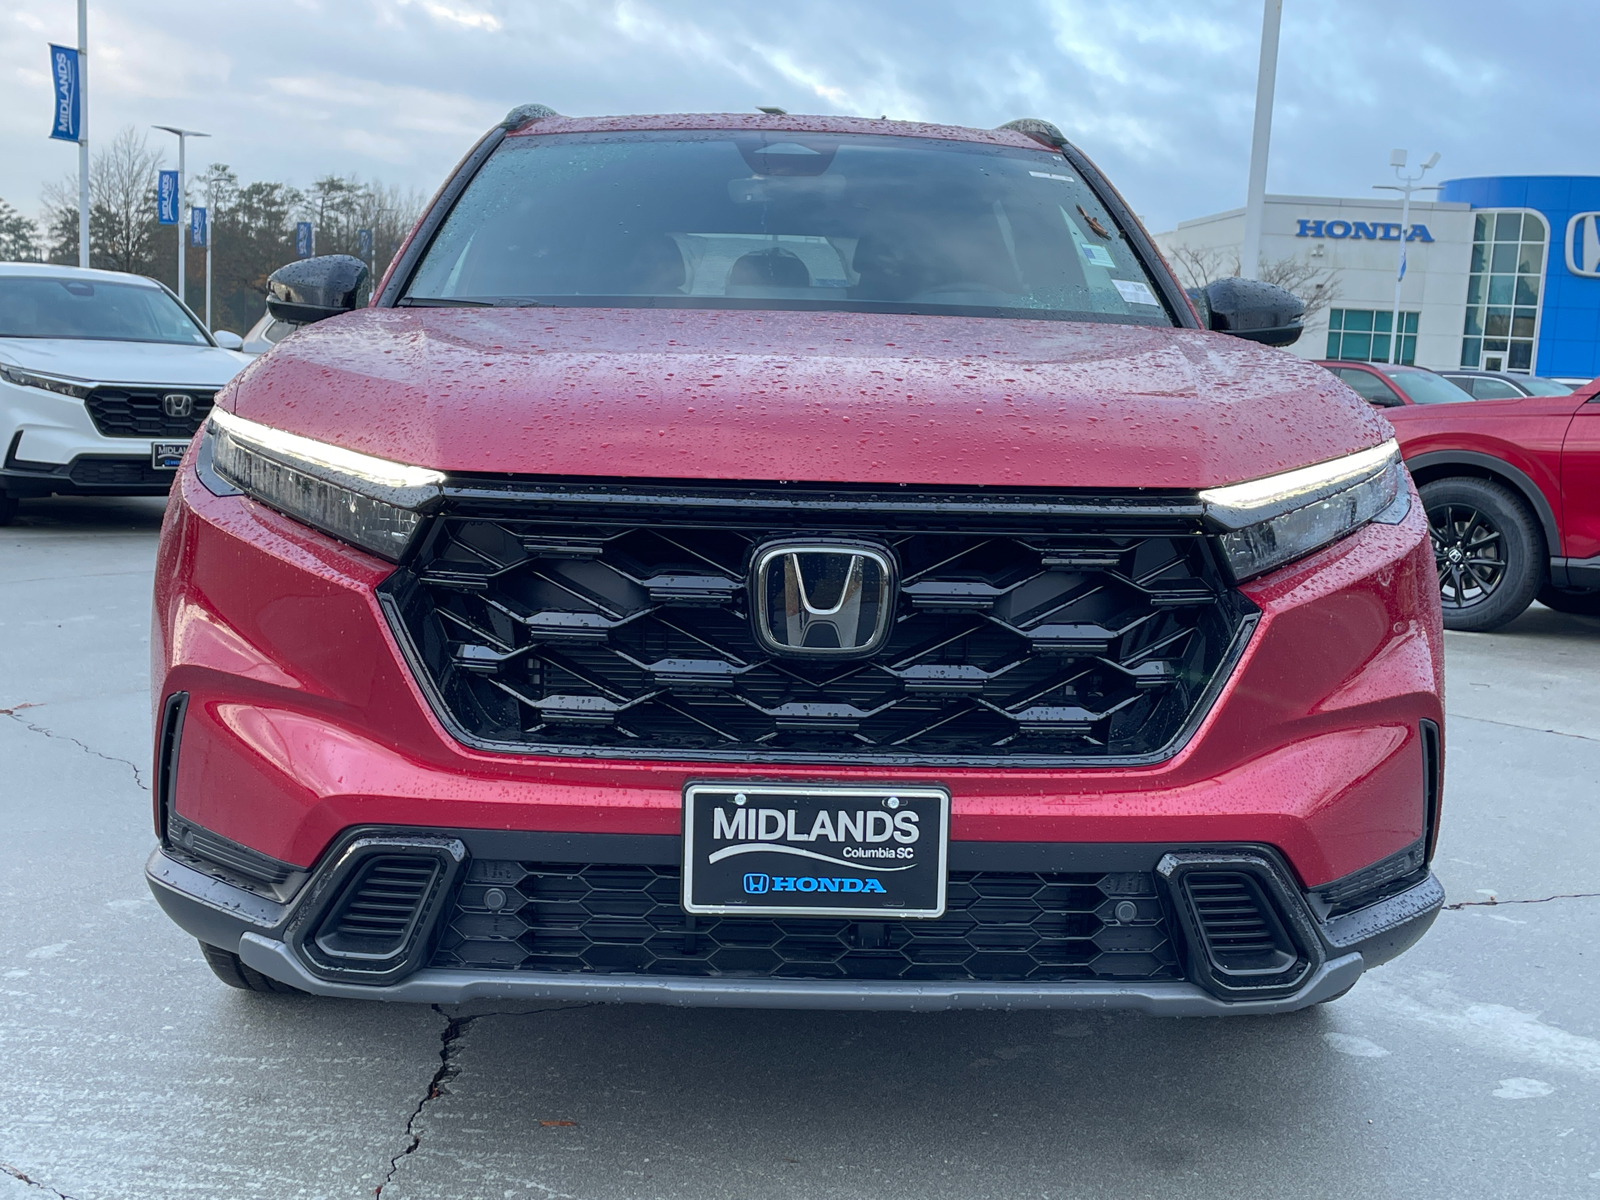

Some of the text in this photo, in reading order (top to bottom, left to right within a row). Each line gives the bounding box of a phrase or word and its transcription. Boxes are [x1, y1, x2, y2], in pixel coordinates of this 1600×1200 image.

[56, 52, 69, 132] MIDLANDS
[162, 174, 170, 220] MIDLANDS
[1295, 219, 1435, 243] HONDA
[158, 446, 187, 454] MIDLAN
[713, 807, 920, 844] MIDLANDS
[843, 847, 914, 859] Columbia SC
[772, 877, 887, 893] HONDA
